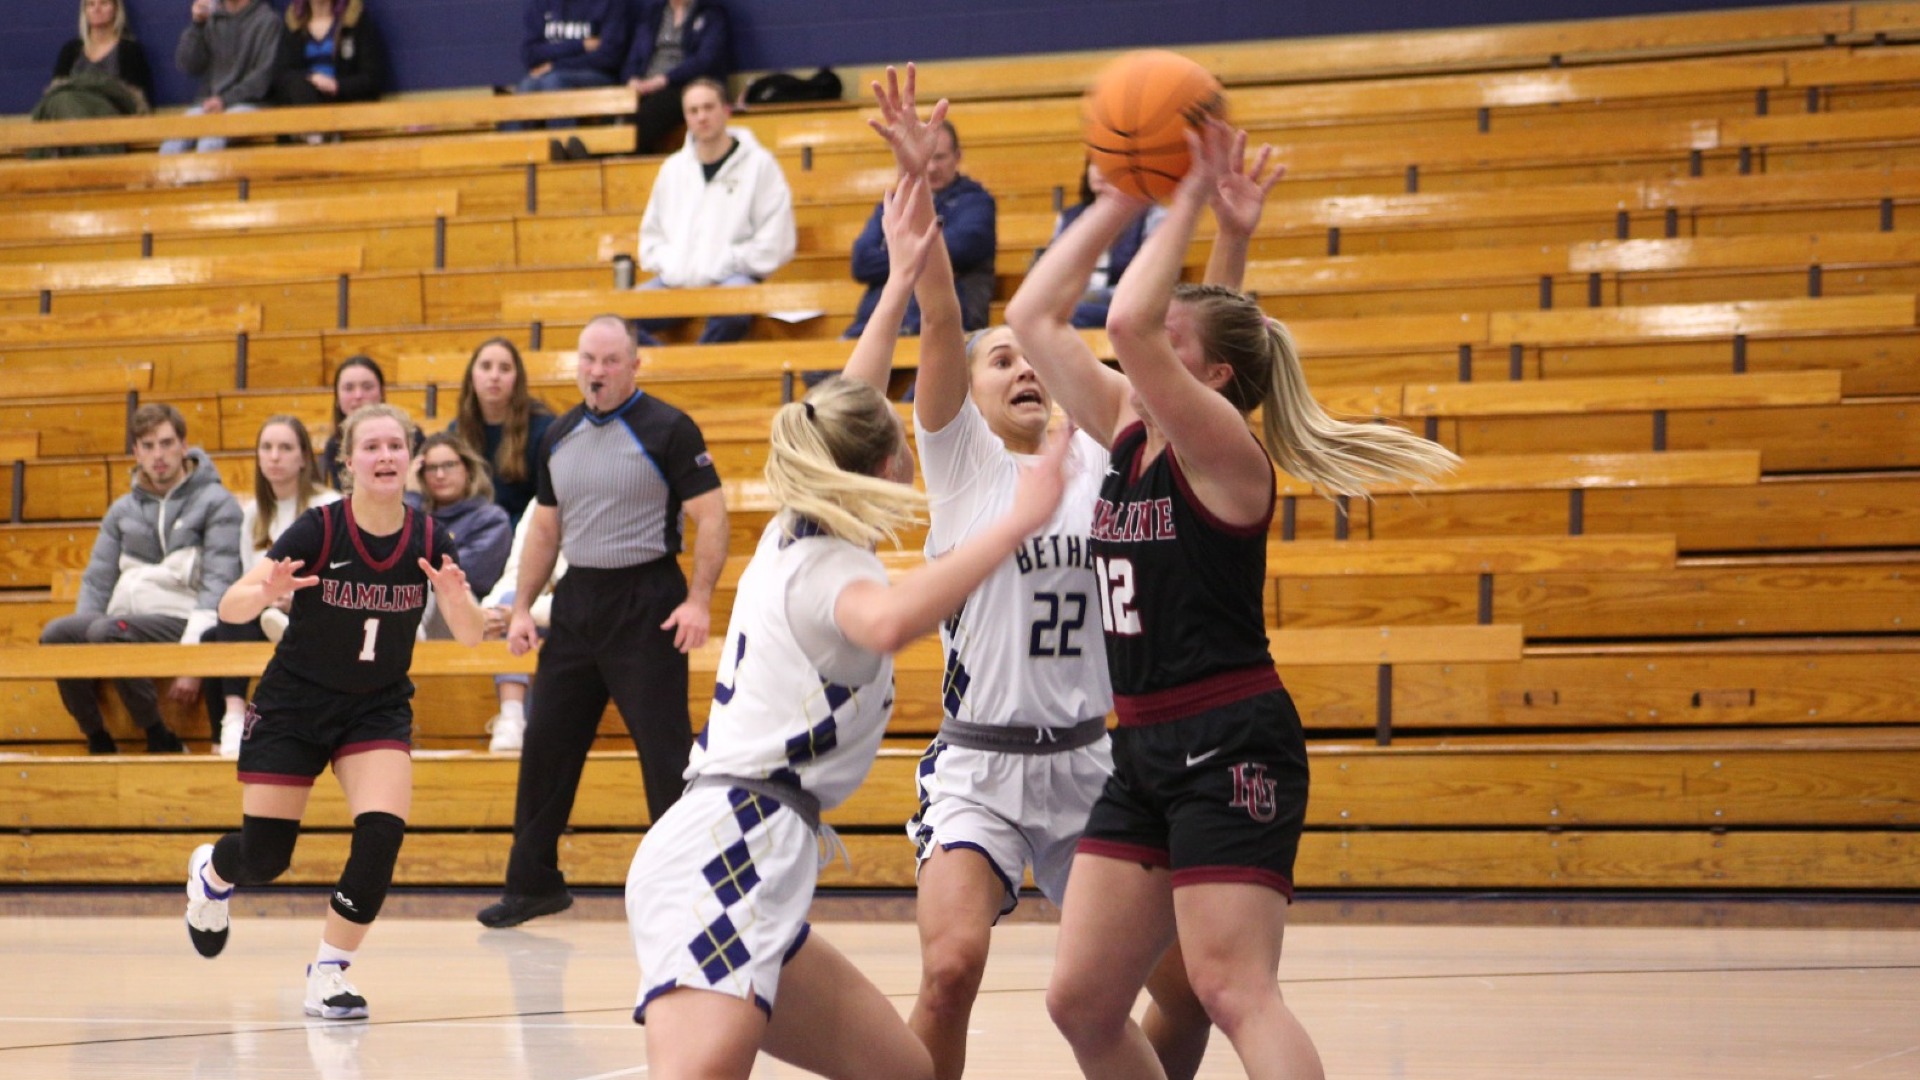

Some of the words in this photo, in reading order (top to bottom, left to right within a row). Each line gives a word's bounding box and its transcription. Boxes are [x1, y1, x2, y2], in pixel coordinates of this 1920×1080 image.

[1029, 592, 1087, 658] 22
[1096, 556, 1142, 635] 12
[358, 618, 380, 662] 1
